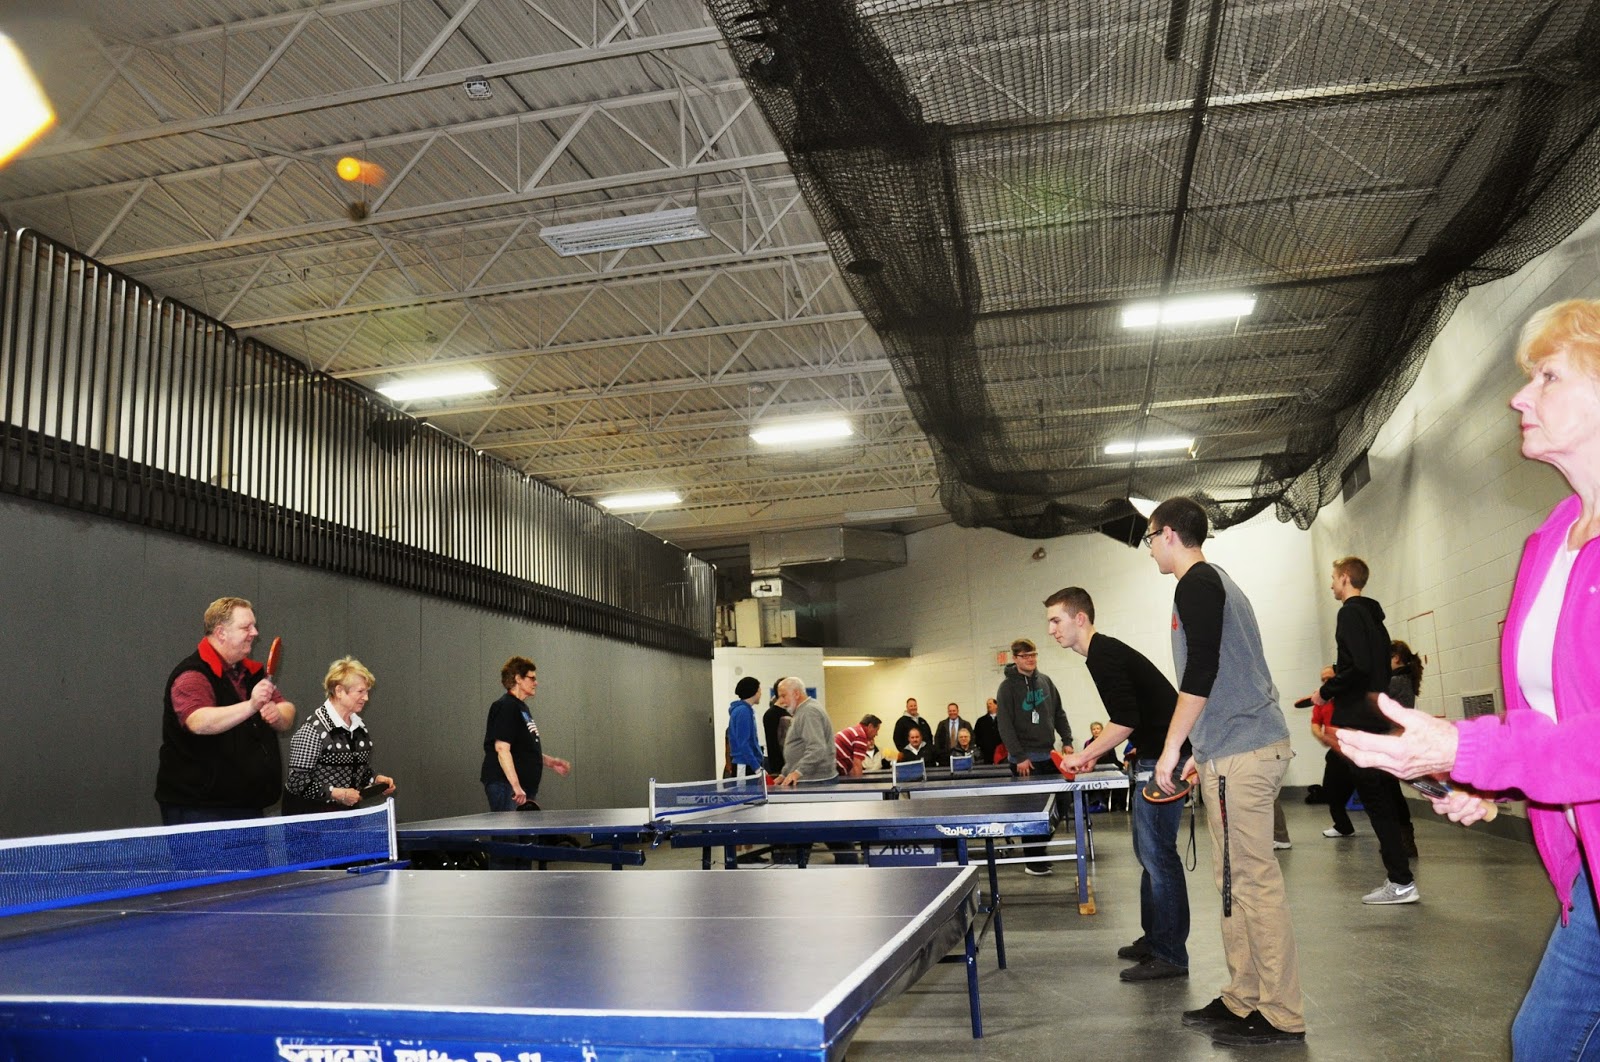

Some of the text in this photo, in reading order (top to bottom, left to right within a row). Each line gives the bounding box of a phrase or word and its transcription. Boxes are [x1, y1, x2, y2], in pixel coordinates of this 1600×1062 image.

[944, 826, 974, 837] Roller
[880, 844, 925, 856] STIGA
[393, 1049, 469, 1062] Elit
